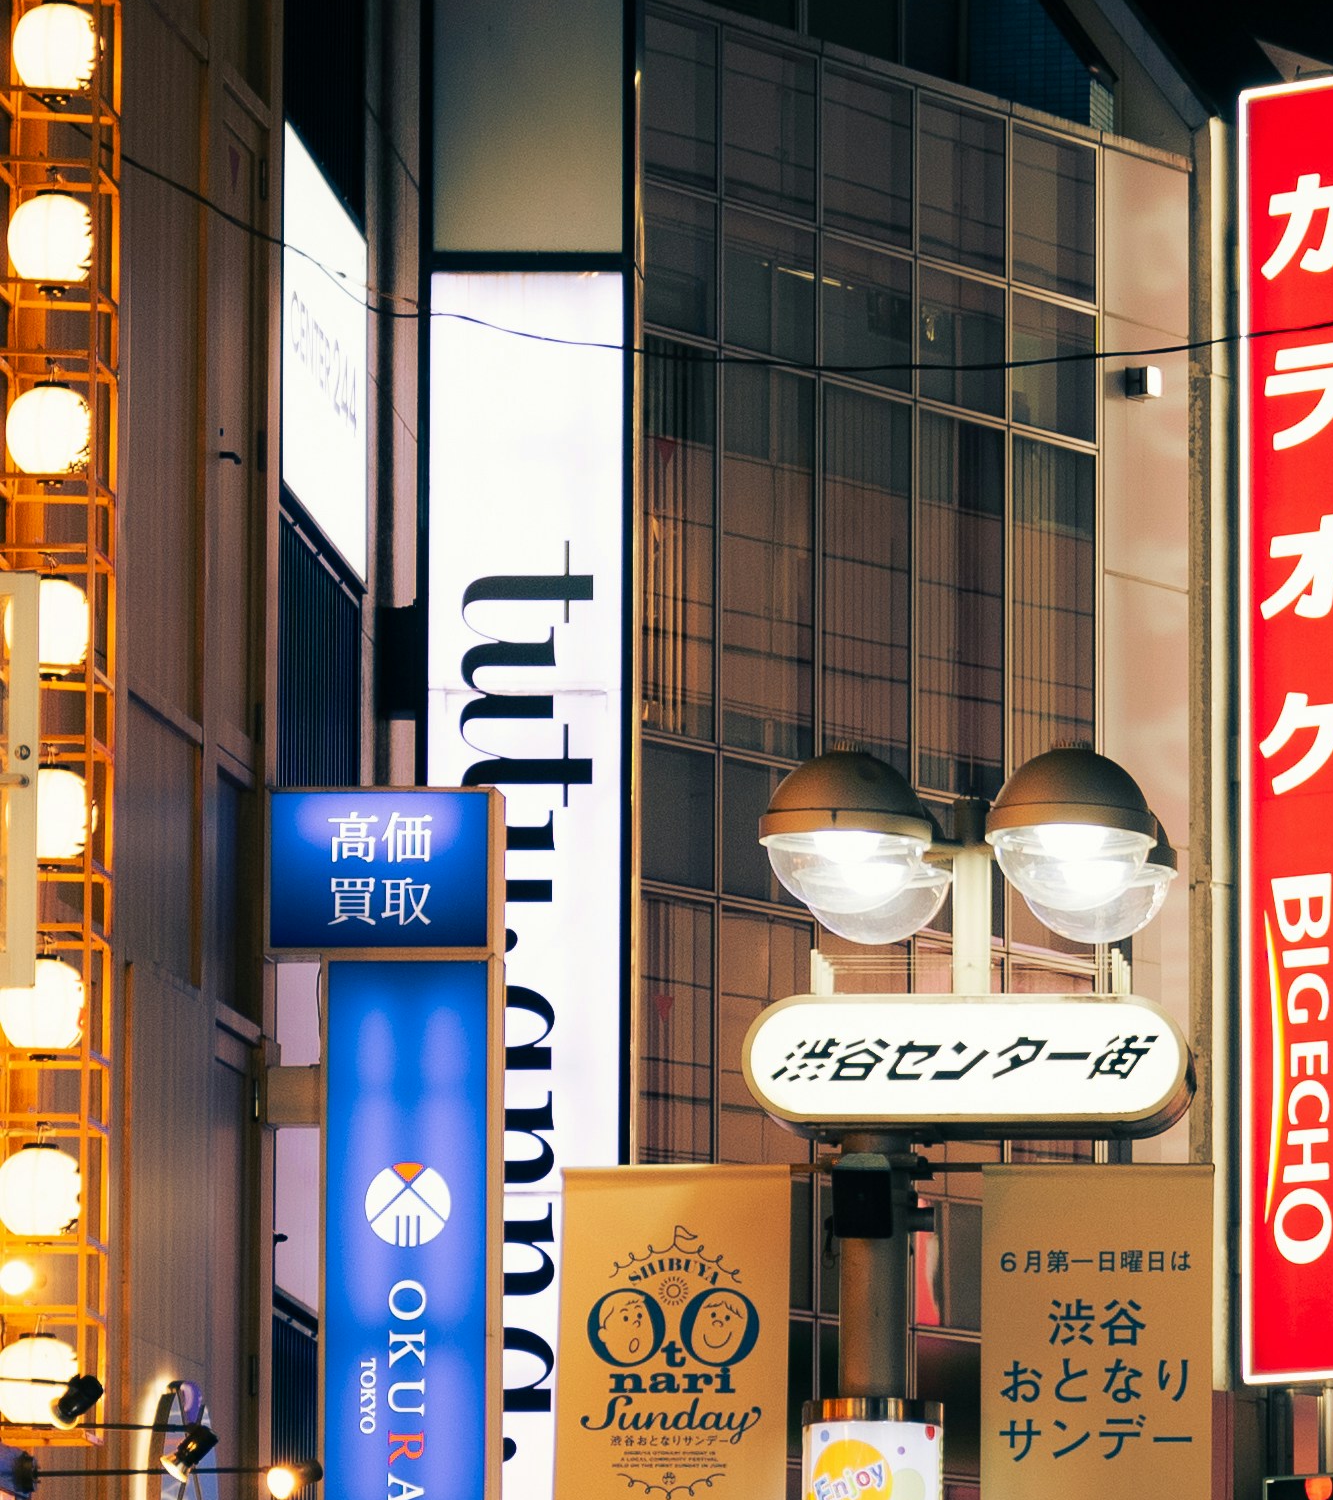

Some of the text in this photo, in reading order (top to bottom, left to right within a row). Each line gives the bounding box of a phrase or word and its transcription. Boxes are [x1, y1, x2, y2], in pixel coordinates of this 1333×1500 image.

[290, 290, 331, 398] CENTER
[328, 811, 434, 864] 高価
[327, 876, 433, 927] 買取
[771, 1035, 1160, 1083] 渋谷センター街
[1268, 874, 1333, 1264] BIG ECHO
[628, 1257, 720, 1287] SHIBUYA
[1000, 1249, 1193, 1275] 6月第一日曜日は
[1048, 1298, 1147, 1348] 渋谷
[358, 1357, 377, 1435] TOKYO
[608, 1366, 736, 1395] nari
[1001, 1356, 1190, 1406] おとなり
[580, 1395, 762, 1446] Sunday
[610, 1435, 730, 1448] 渋谷おとなりサンデー
[1000, 1418, 1194, 1463] サンデー
